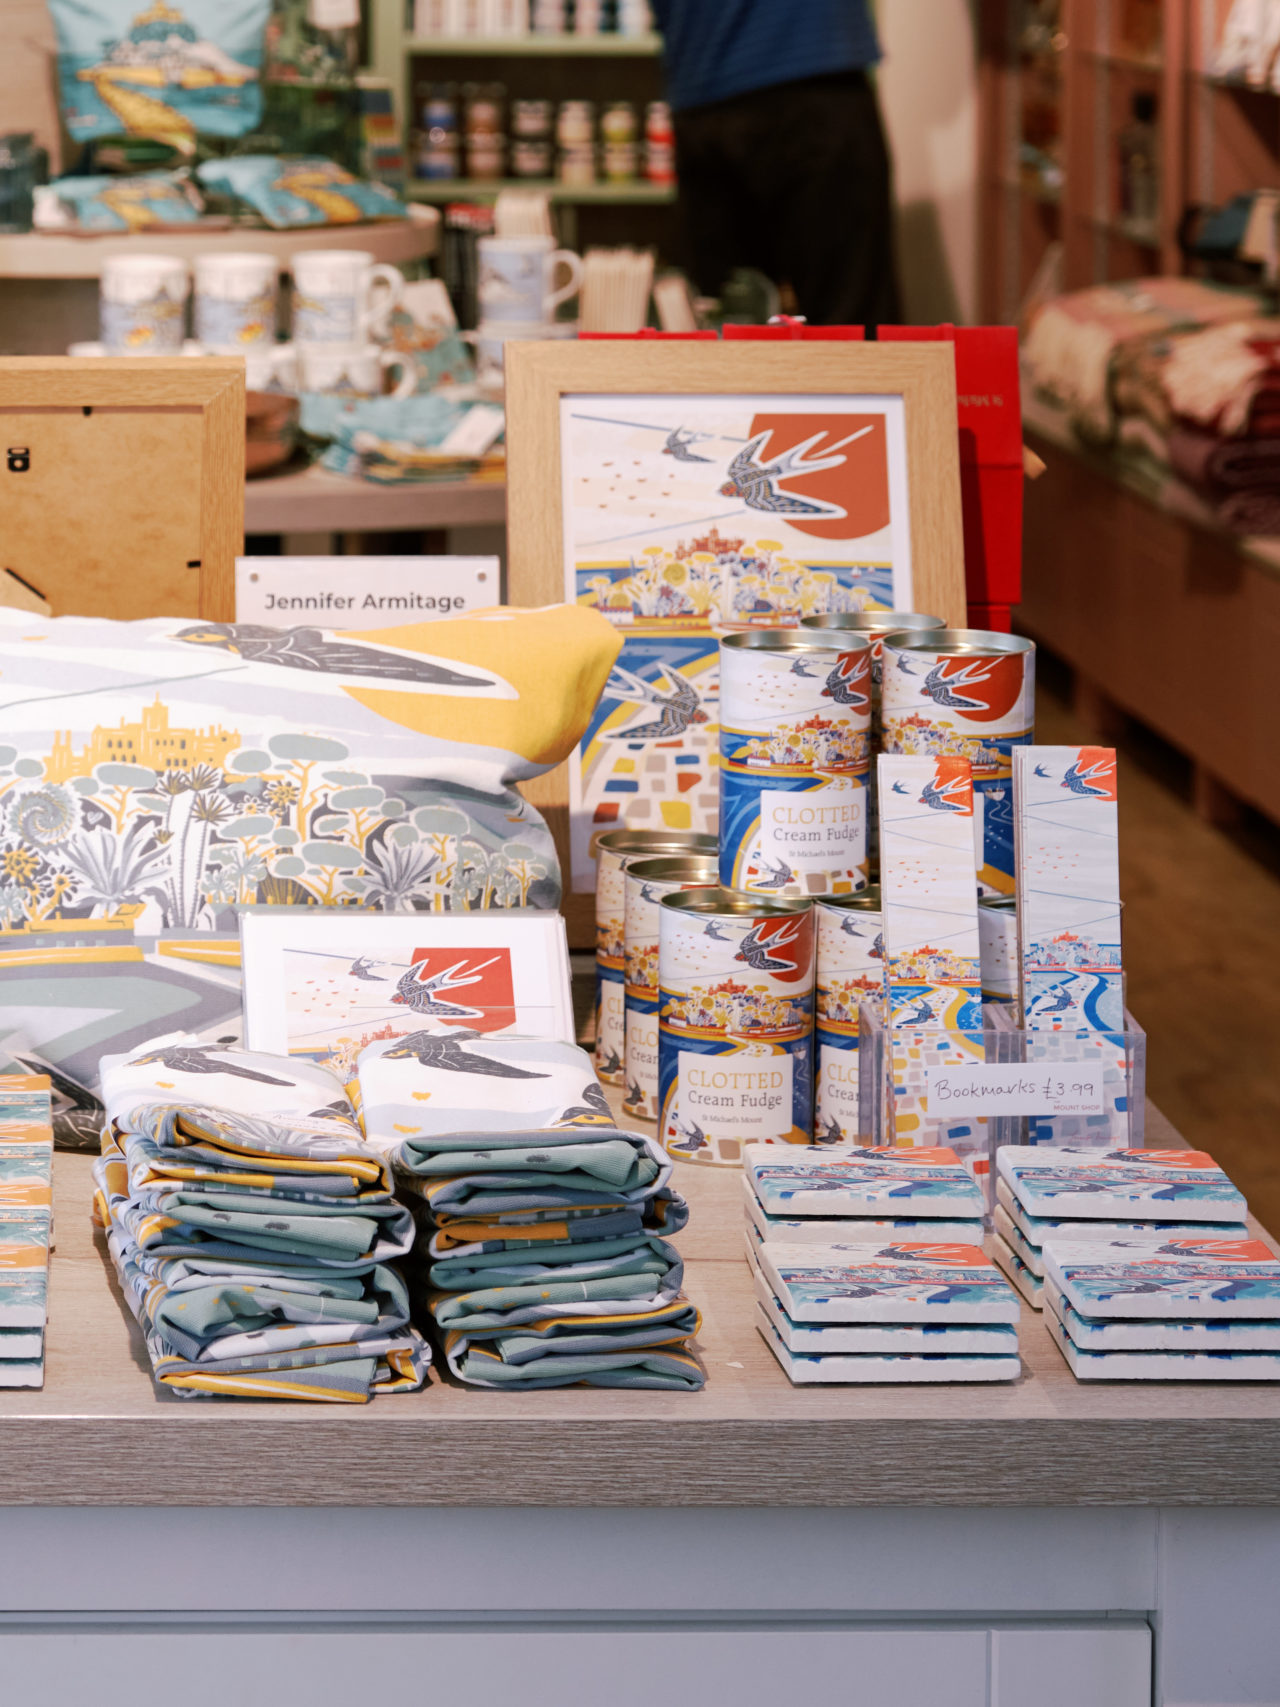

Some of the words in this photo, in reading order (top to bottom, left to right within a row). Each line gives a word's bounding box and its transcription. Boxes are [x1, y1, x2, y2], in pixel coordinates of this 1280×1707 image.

[265, 591, 355, 610] Jennifer
[362, 591, 466, 613] Armitage
[772, 803, 861, 825] CLOTTED
[773, 827, 822, 842] Cream
[826, 824, 860, 843] Fudge
[687, 1068, 784, 1090] CLOTTED
[934, 1078, 1036, 1100] Bookmarks
[1042, 1077, 1095, 1100] £3.99
[688, 1089, 735, 1107] Cream
[740, 1091, 783, 1111] Fudge
[1053, 1104, 1080, 1112] MOUNT
[1081, 1104, 1101, 1112] SHOP
